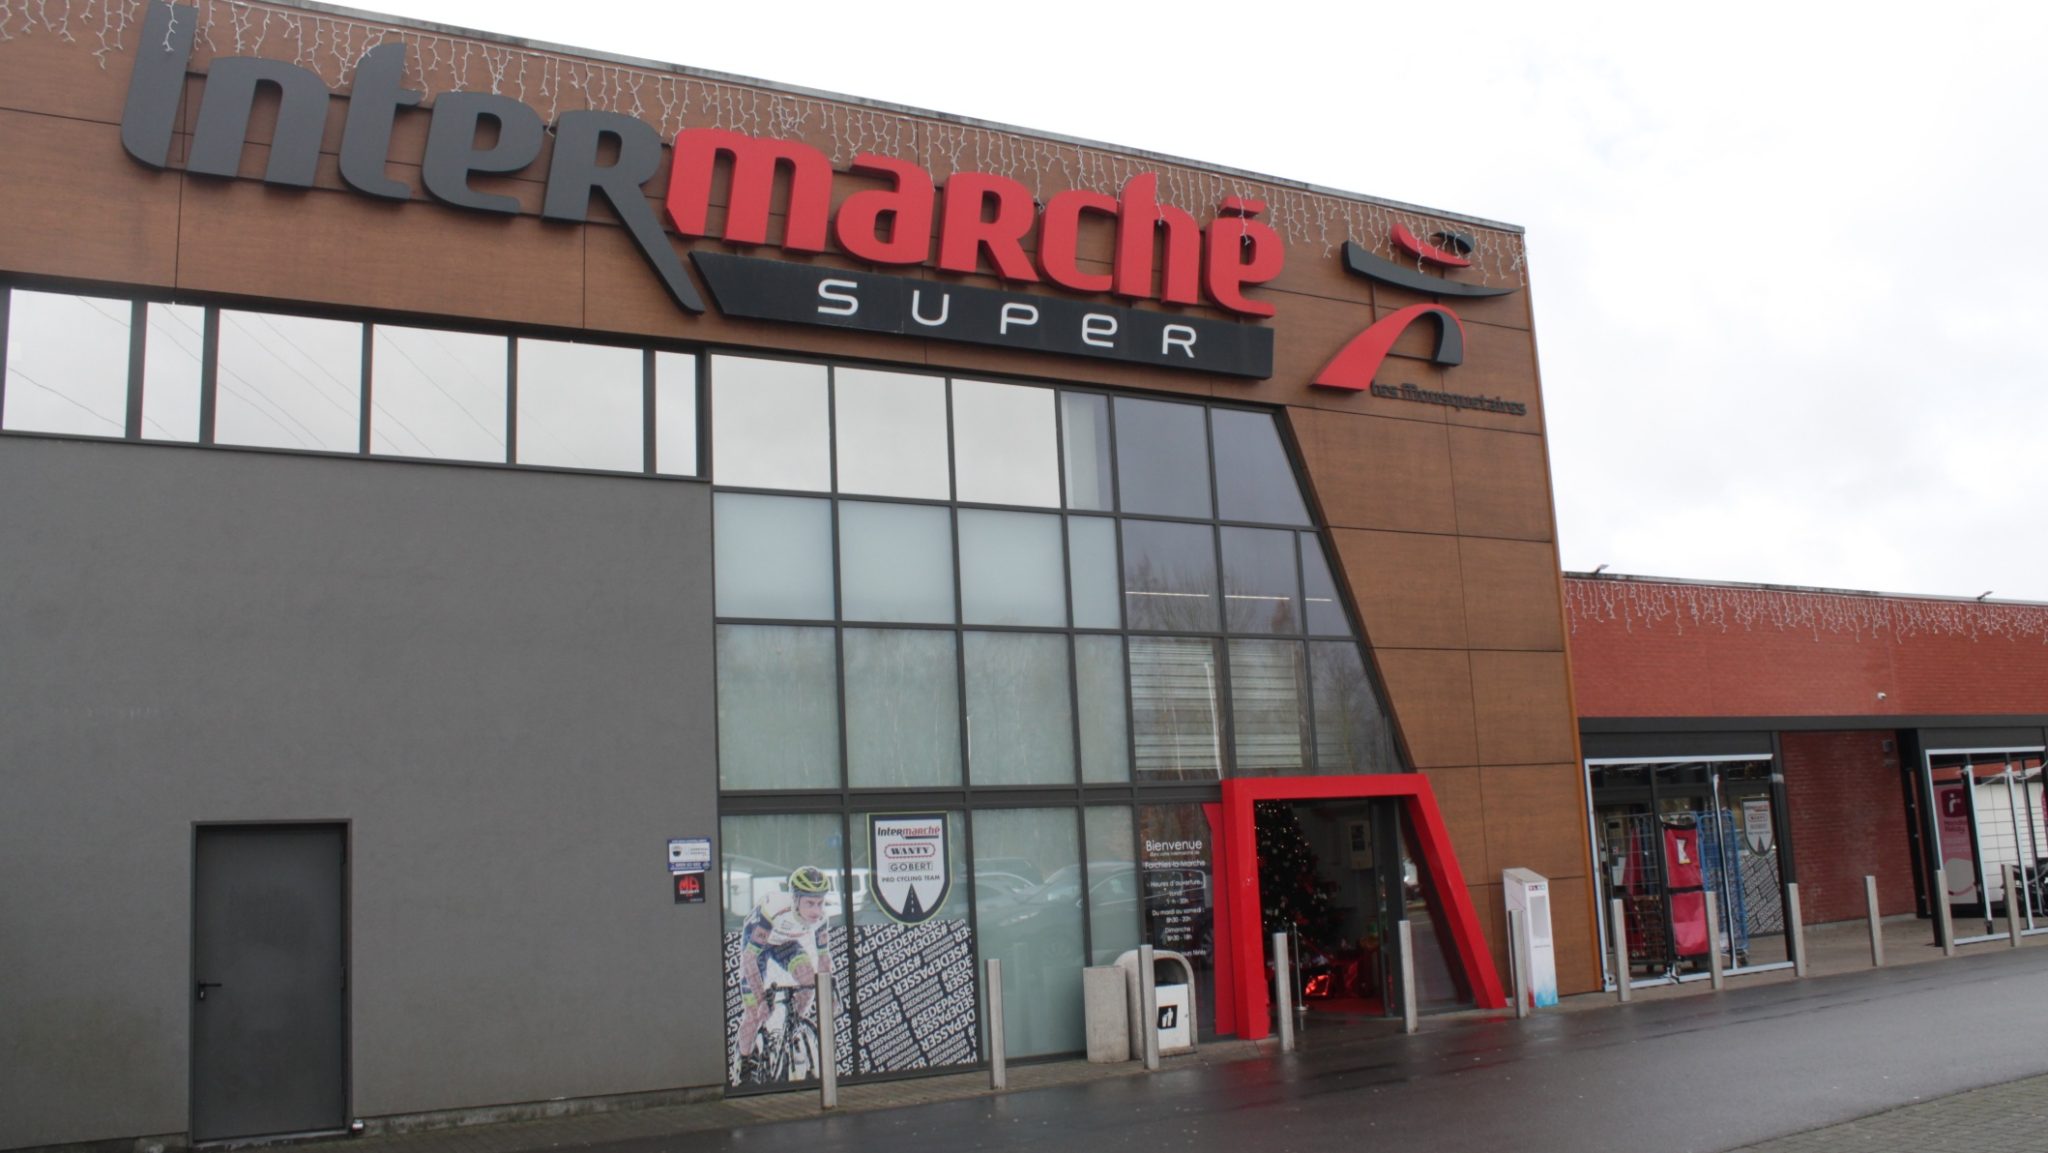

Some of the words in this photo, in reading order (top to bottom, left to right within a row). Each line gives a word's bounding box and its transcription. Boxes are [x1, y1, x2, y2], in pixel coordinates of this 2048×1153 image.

[891, 846, 929, 855] WANTY
[1145, 840, 1202, 852] Bienvenue
[890, 862, 931, 872] GOBERT
